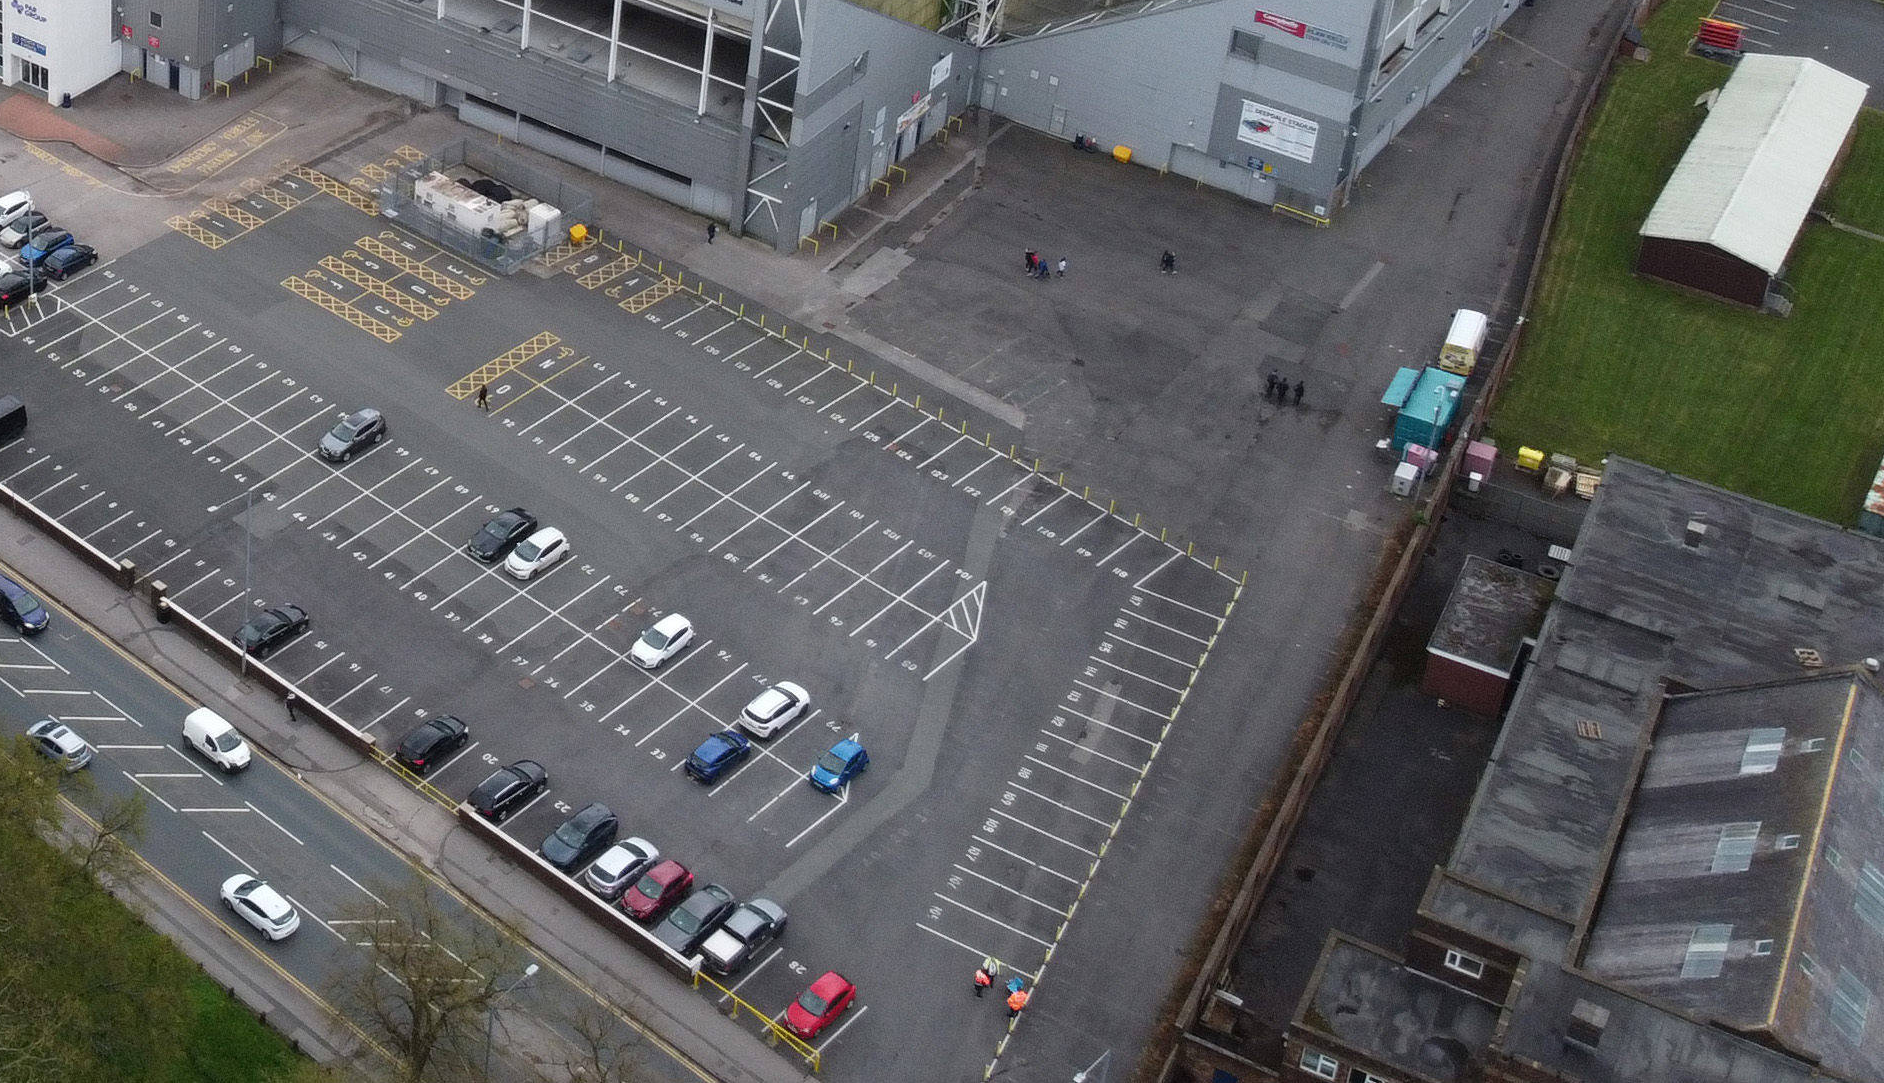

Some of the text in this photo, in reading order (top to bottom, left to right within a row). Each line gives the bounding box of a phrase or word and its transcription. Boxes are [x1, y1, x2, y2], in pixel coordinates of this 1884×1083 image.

[25, 10, 47, 22] GROUP
[1255, 108, 1318, 132] DEEPDALE STADIUM
